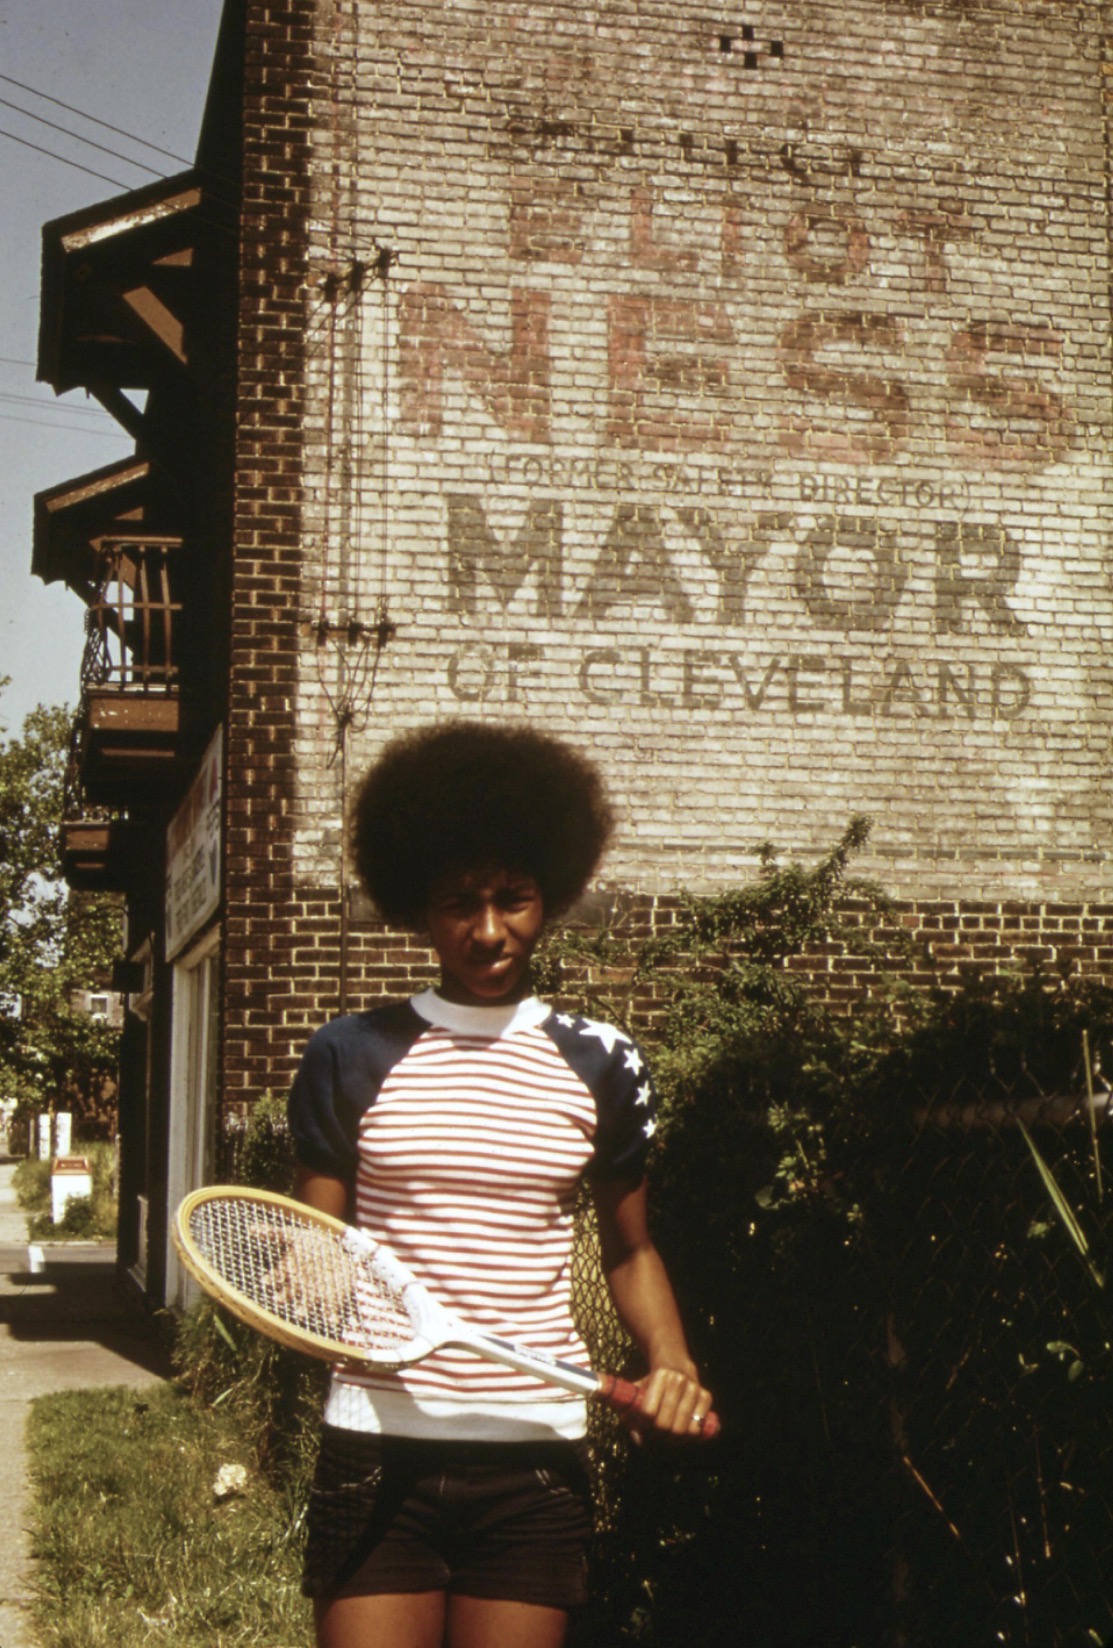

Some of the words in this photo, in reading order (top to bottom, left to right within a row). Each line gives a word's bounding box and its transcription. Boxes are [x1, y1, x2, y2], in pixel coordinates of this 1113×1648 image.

[510, 177, 972, 294] ELIOT
[400, 288, 1074, 465] NESS
[446, 493, 1030, 636] MAYOR
[446, 645, 545, 701] OF
[579, 650, 1031, 724] CLEVELAND
